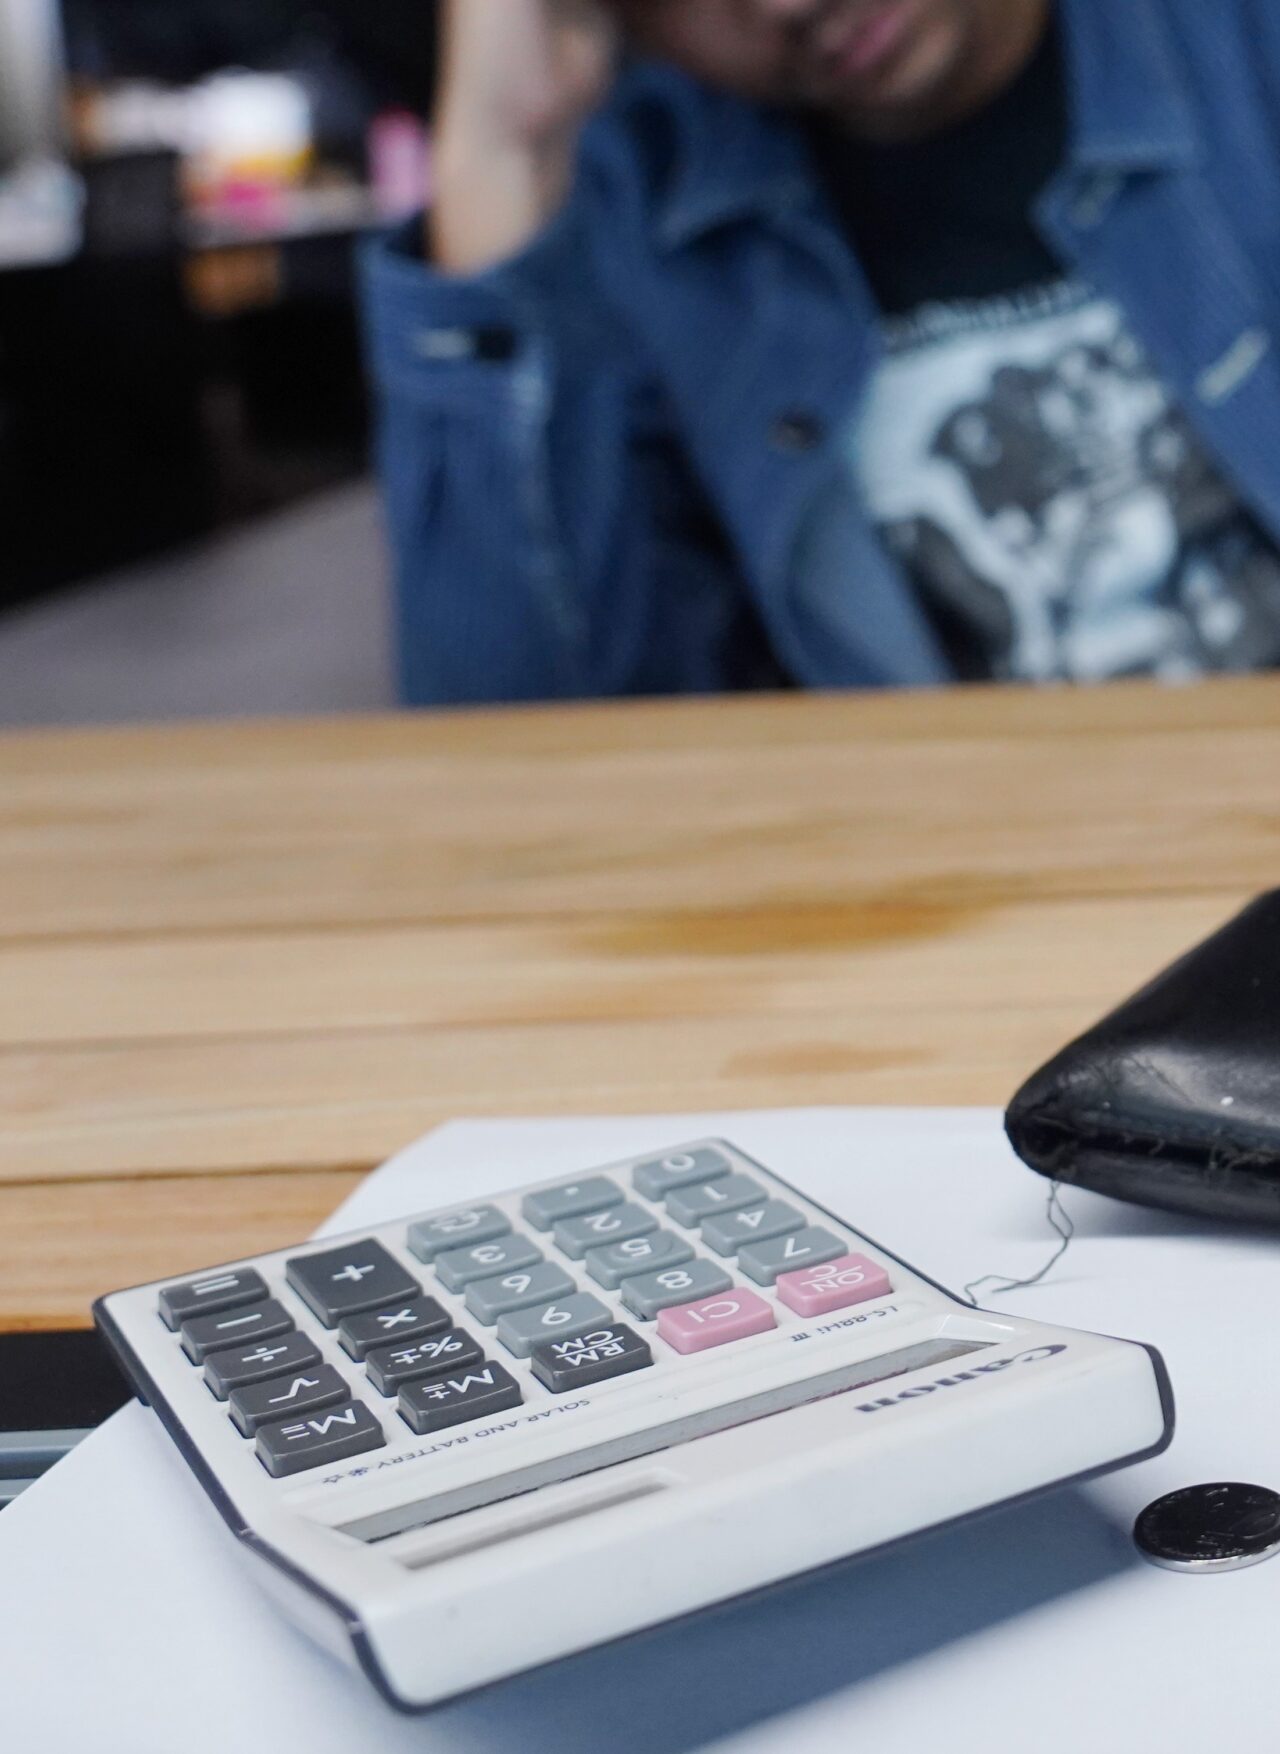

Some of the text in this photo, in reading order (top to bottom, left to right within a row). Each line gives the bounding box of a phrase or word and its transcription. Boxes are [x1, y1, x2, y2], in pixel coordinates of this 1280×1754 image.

[661, 1154, 696, 1173] 0
[703, 1185, 728, 1202] 1
[584, 1212, 622, 1232] 2
[736, 1209, 766, 1228] 4
[469, 1245, 507, 1264] 3
[619, 1237, 653, 1258] 5
[783, 1237, 811, 1259] 7
[501, 1274, 532, 1293] 6
[656, 1270, 694, 1290] 8
[811, 1270, 866, 1293] ON
[541, 1306, 572, 1326] 9
[551, 1330, 614, 1352] CM
[564, 1345, 626, 1367] RM
[854, 1343, 1068, 1413] Canon
[376, 1398, 592, 1470] SOLAR AND BATTERY
